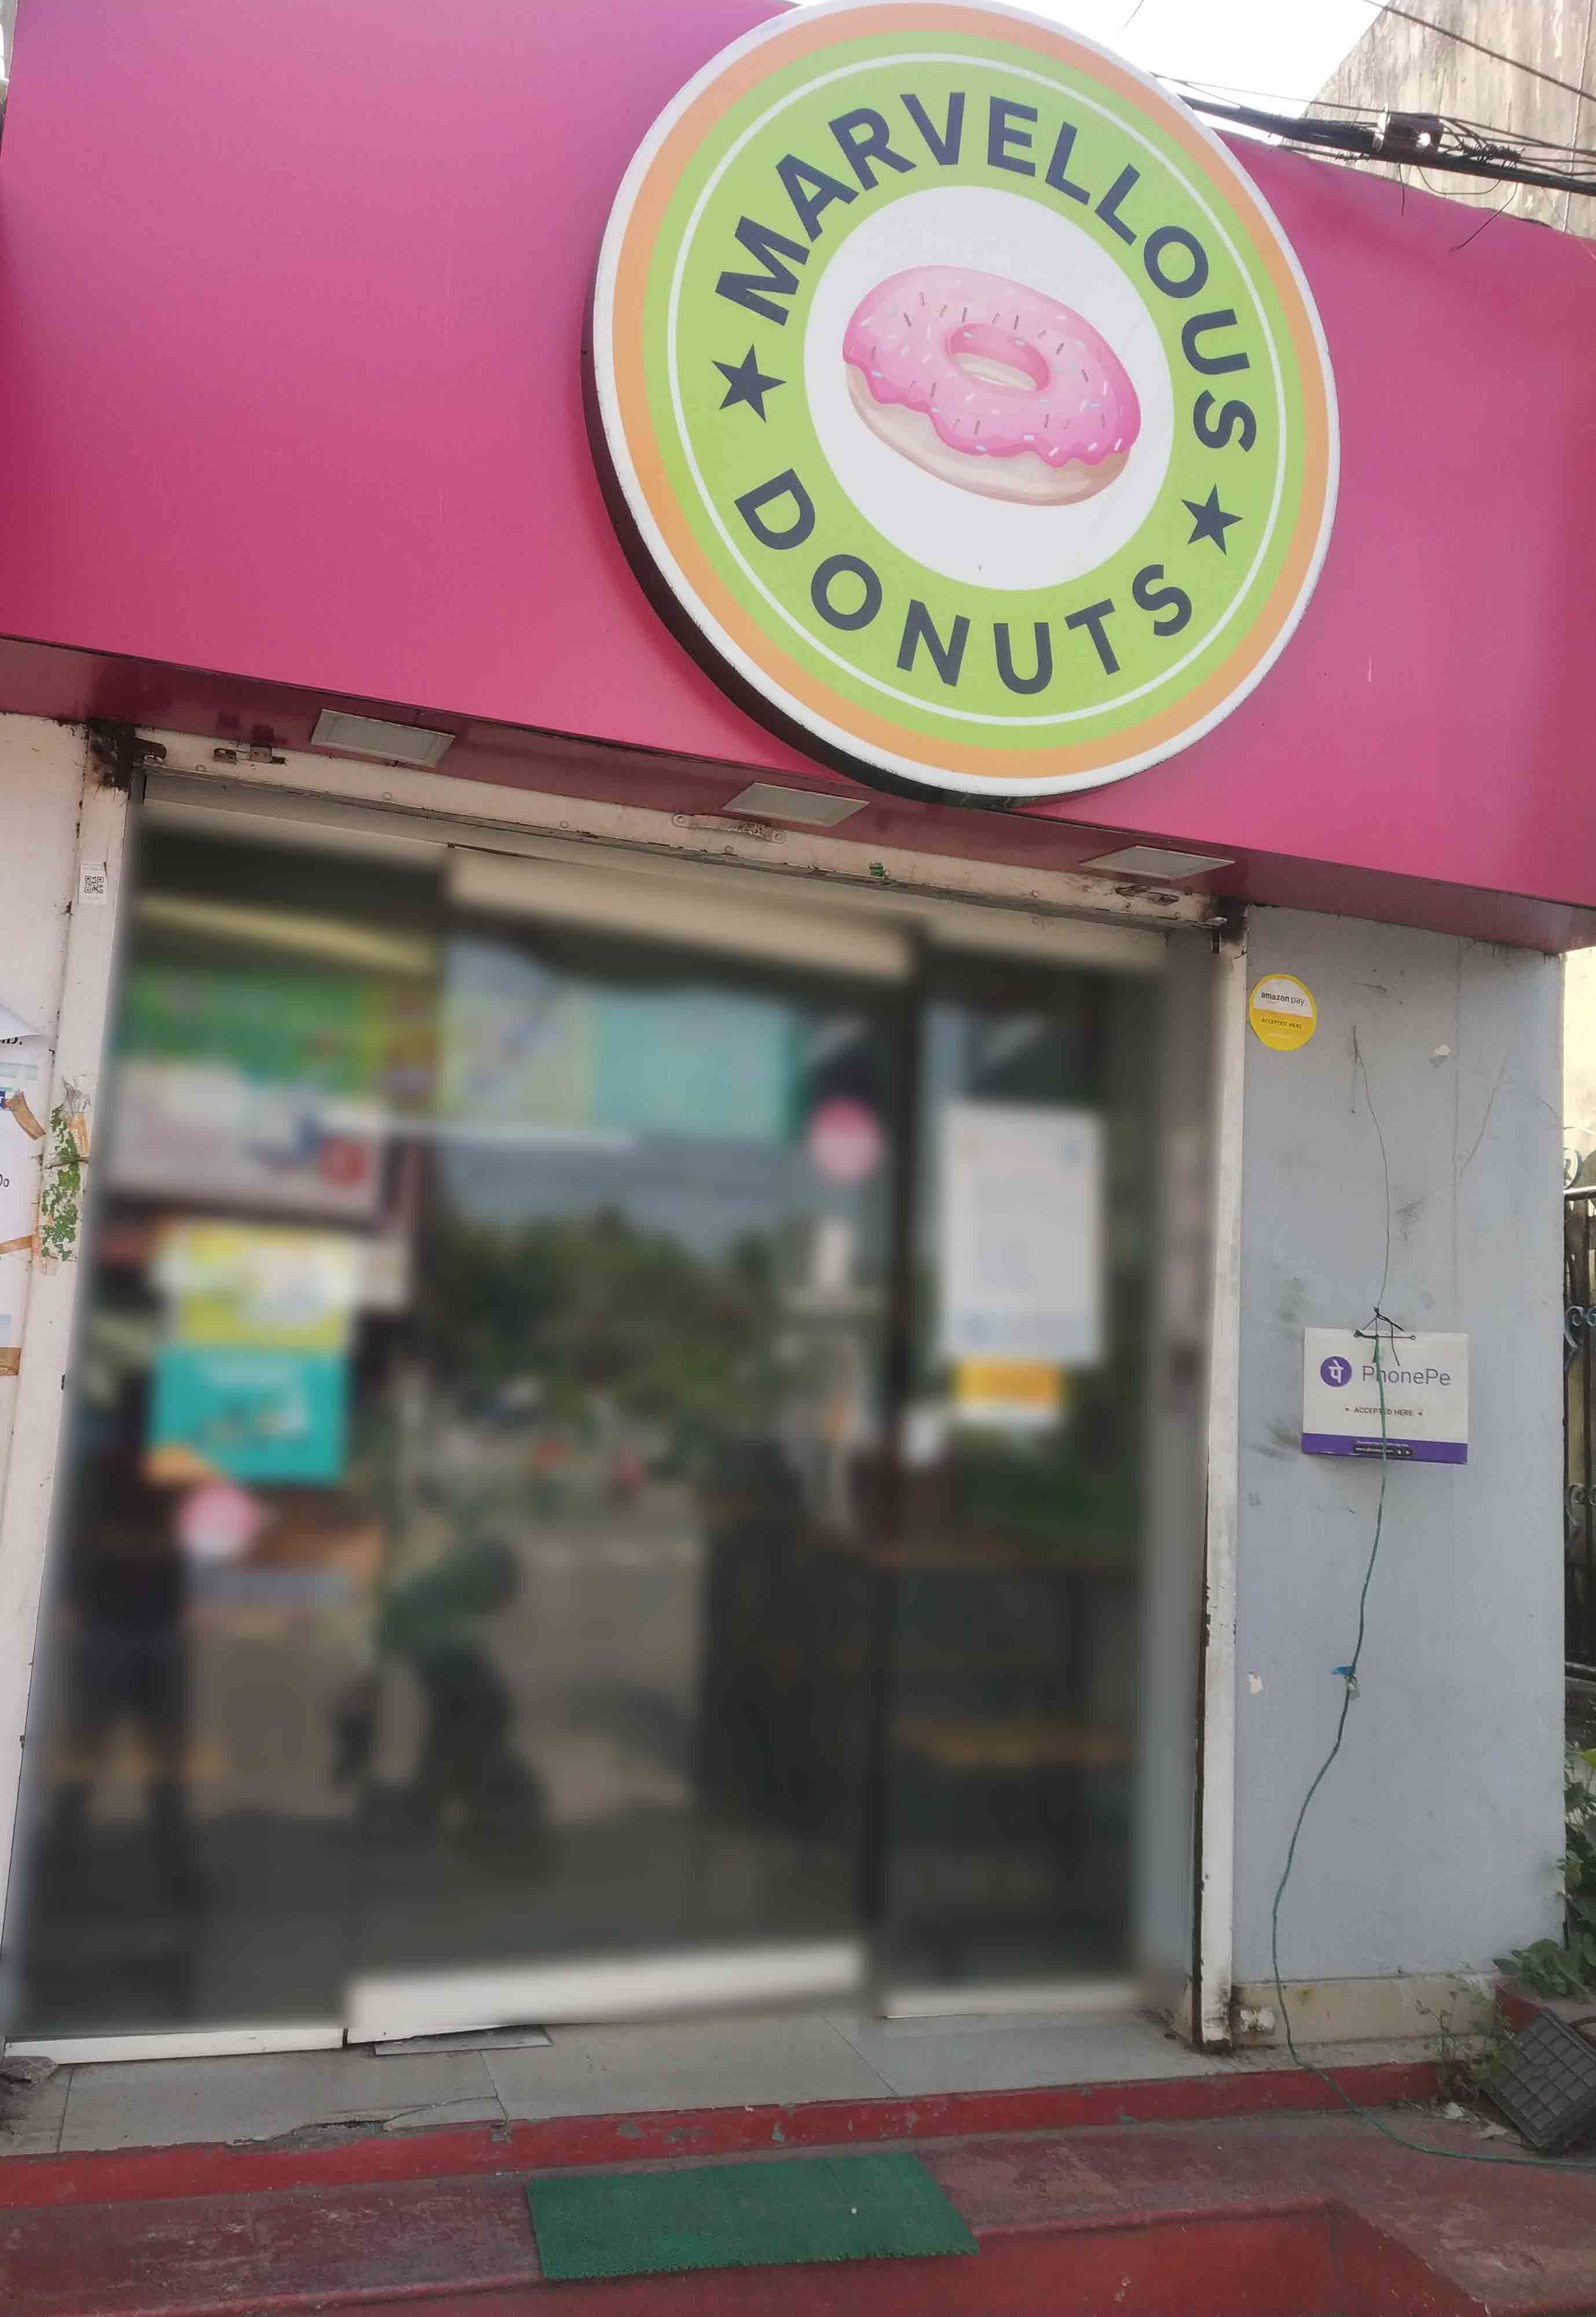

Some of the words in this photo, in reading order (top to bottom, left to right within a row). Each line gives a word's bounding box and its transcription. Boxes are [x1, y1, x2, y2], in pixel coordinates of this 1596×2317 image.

[715, 92, 1257, 453] MARVELLOUS
[734, 468, 1192, 695] DONUTS
[1261, 992, 1290, 1003] amazon
[1291, 997, 1305, 1007] pay
[1394, 1409, 1414, 1417] HERE
